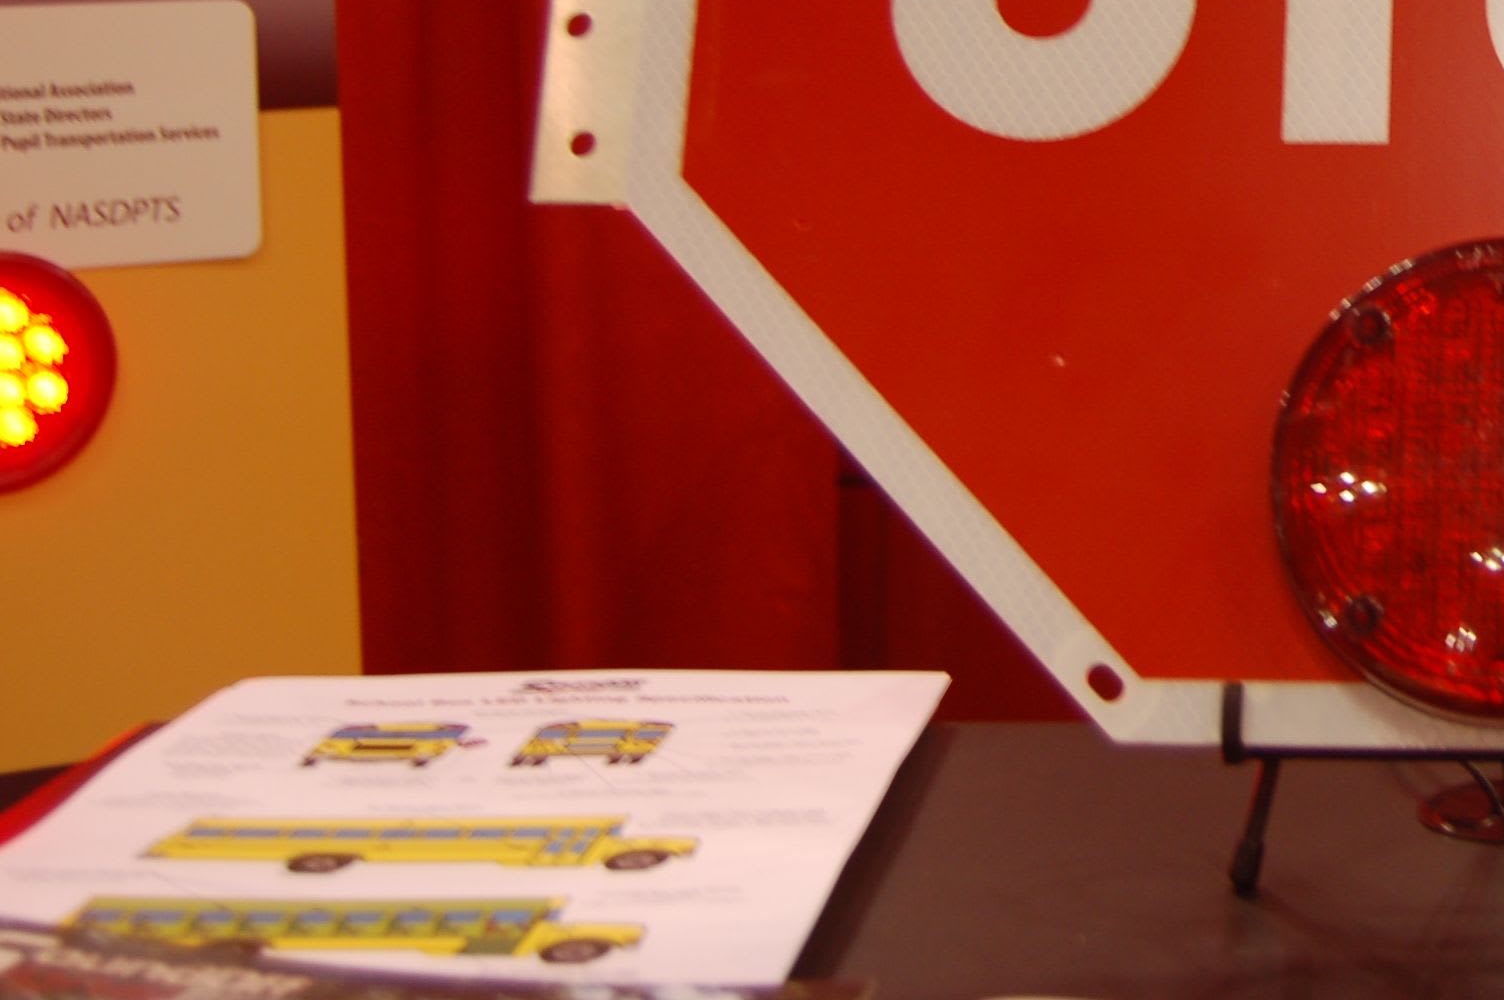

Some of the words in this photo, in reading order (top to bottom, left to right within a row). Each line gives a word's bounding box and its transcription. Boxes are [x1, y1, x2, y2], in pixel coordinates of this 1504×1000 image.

[49, 80, 135, 99] Association
[1, 109, 40, 125] State
[44, 106, 113, 125] Directors
[1, 132, 41, 152] Pupil
[45, 130, 156, 150] Transportation
[159, 125, 220, 143] Services
[6, 204, 39, 233] of
[50, 195, 182, 231] NASDPTS
